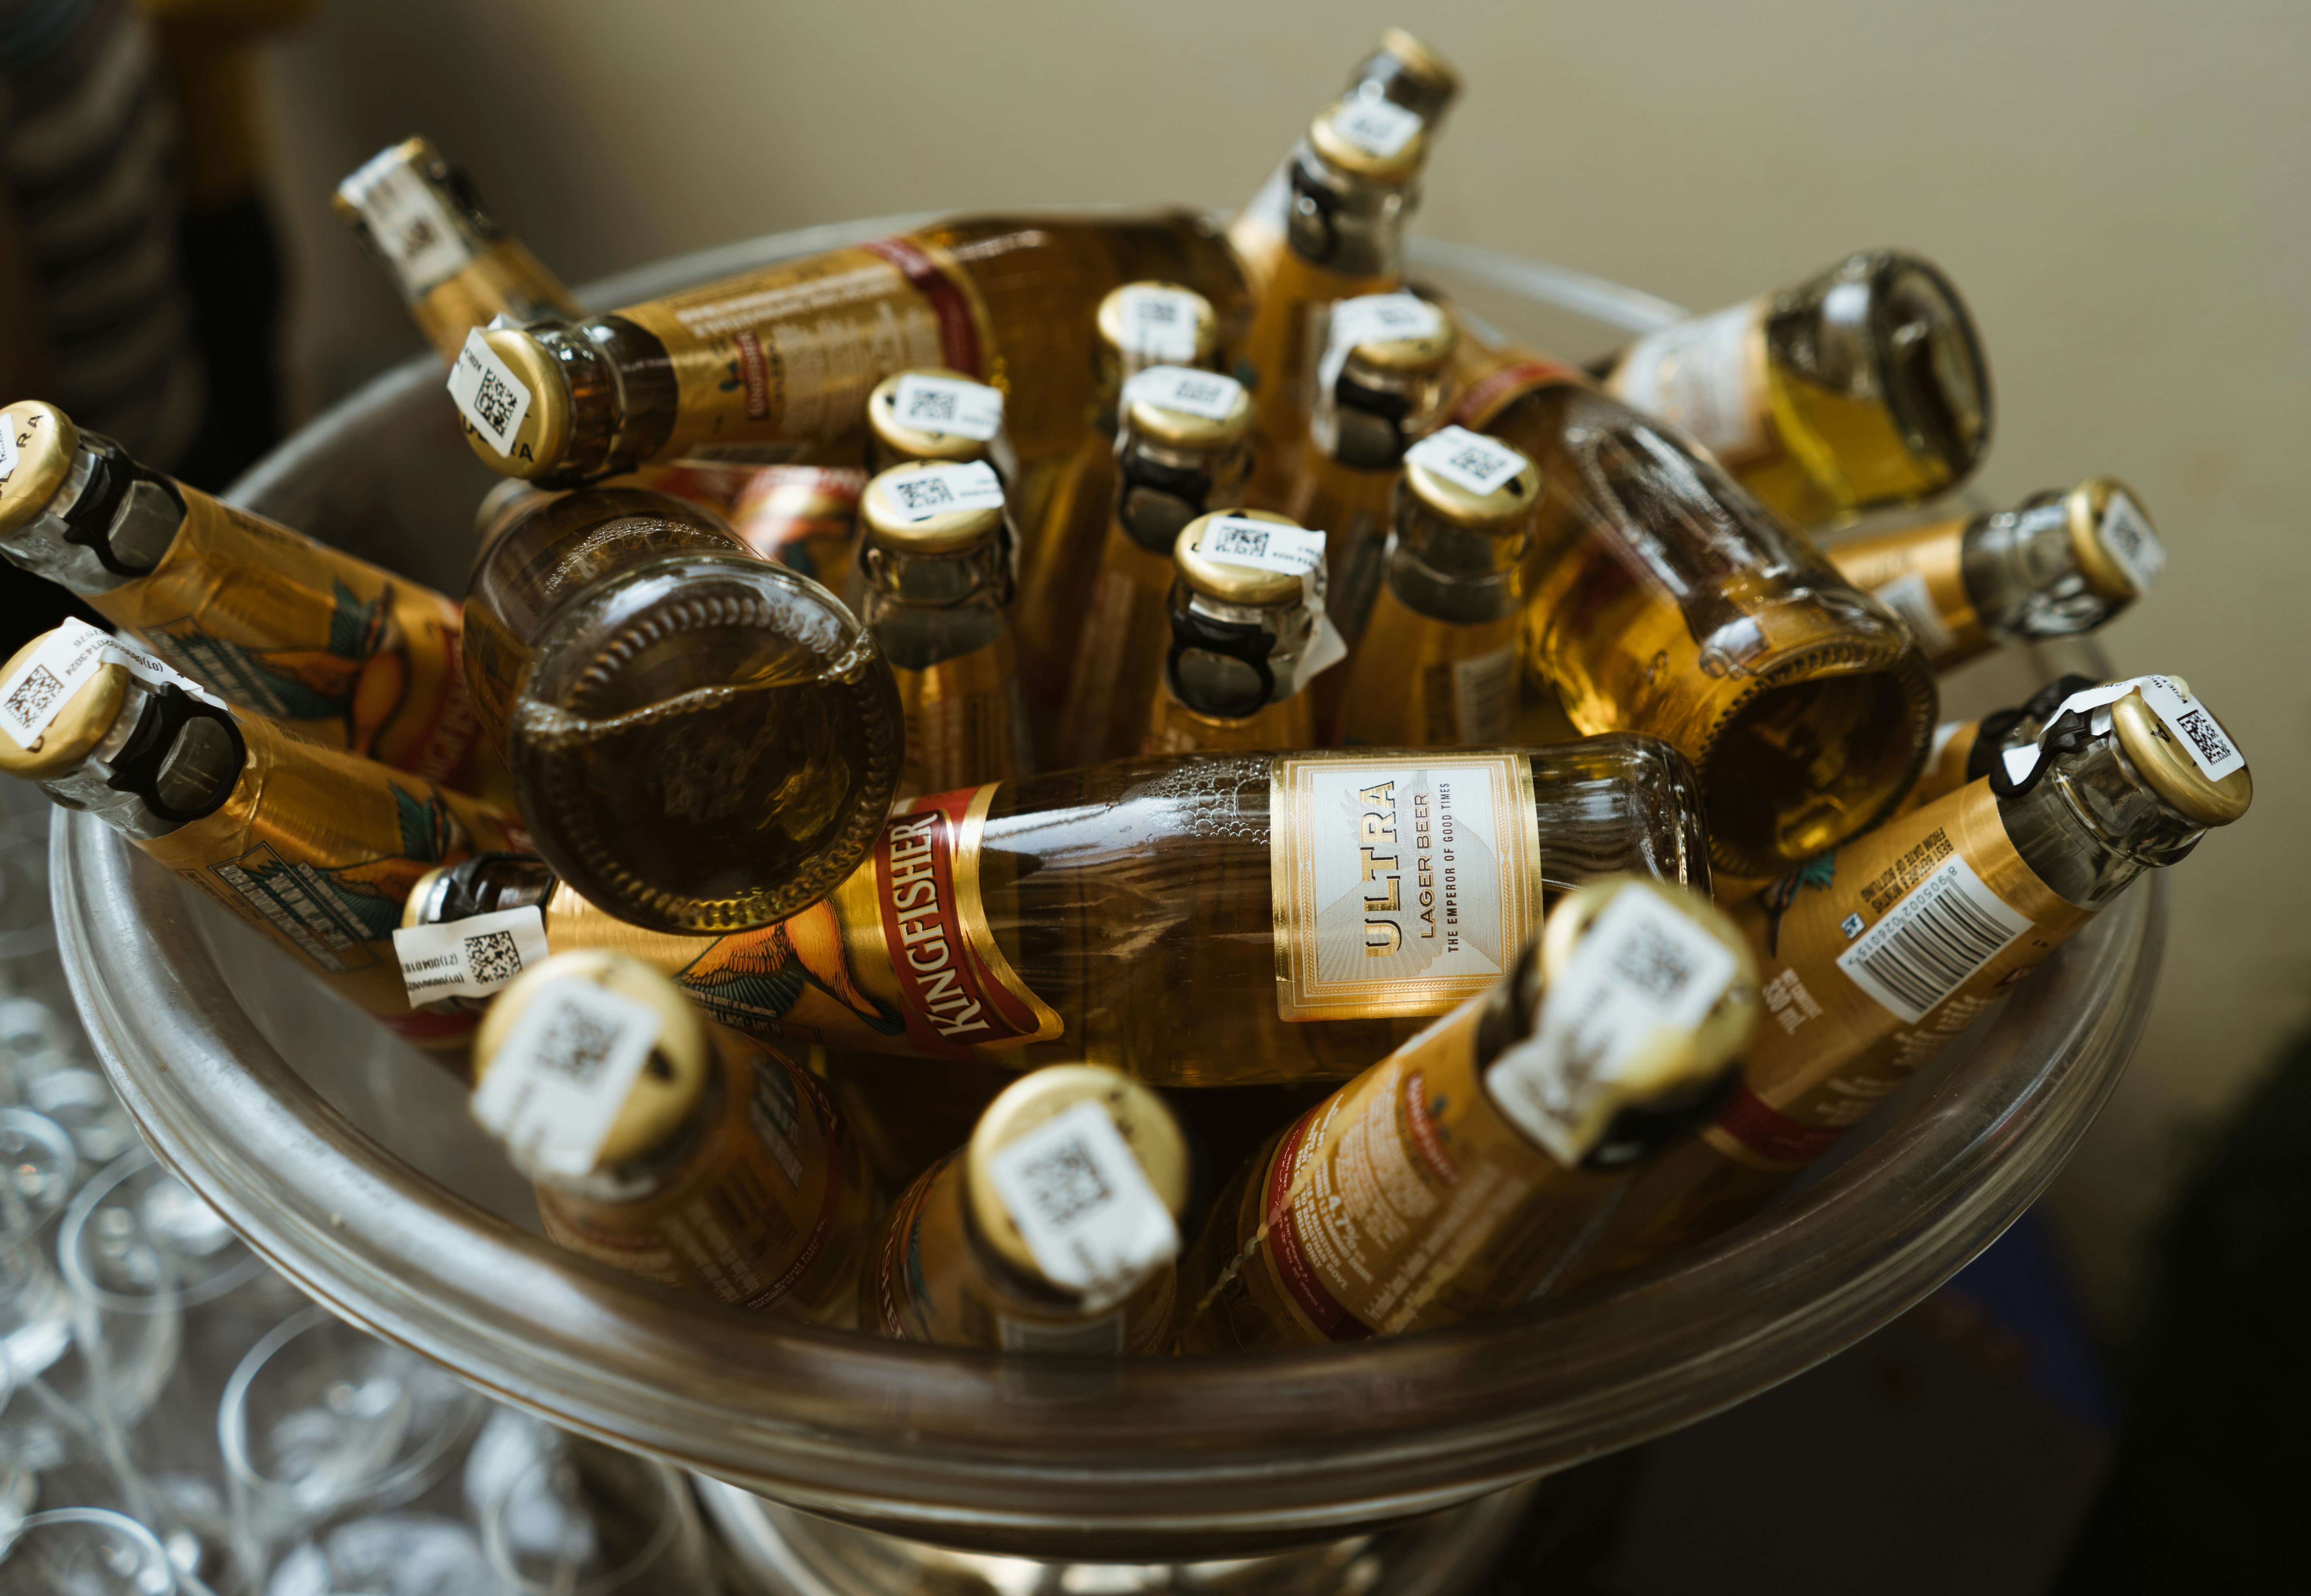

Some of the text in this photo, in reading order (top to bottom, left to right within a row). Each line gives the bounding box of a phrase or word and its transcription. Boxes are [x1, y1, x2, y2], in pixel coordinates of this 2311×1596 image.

[1923, 827, 1946, 851] FROM
[1933, 839, 1953, 862] BEST
[1360, 781, 1402, 957] ULTRA
[1414, 793, 1436, 939] LAGER BEER
[1440, 783, 1459, 953] THE EMPEROR OF GOOD TIMES
[1895, 858, 1906, 875] OF
[1906, 854, 1935, 885] BEFORE
[1948, 866, 1958, 877] 8
[1902, 875, 1947, 917] 905002
[890, 812, 991, 1037] KINGFISHER
[1857, 915, 1901, 958] 026015
[733, 1001, 739, 1009] OF
[740, 1002, 776, 1017] CONSUMPTION
[719, 1012, 745, 1028] DON'T
[1295, 1149, 1304, 1170] FOR
[1294, 1195, 1301, 1210] IN
[1300, 1190, 1307, 1206] TO
[1307, 1198, 1318, 1213] IN
[1296, 1210, 1309, 1242] DELHI
[1302, 1206, 1328, 1263] RAJASTHAN
[1328, 1195, 1360, 1250] 4.7%
[1311, 1213, 1342, 1267] RAJASTHAN
[747, 1218, 826, 1307] Max. Retail Price Rs.
[1305, 1242, 1322, 1269] ONLY
[786, 1276, 795, 1285] OF
[795, 1265, 806, 1276] ALL
